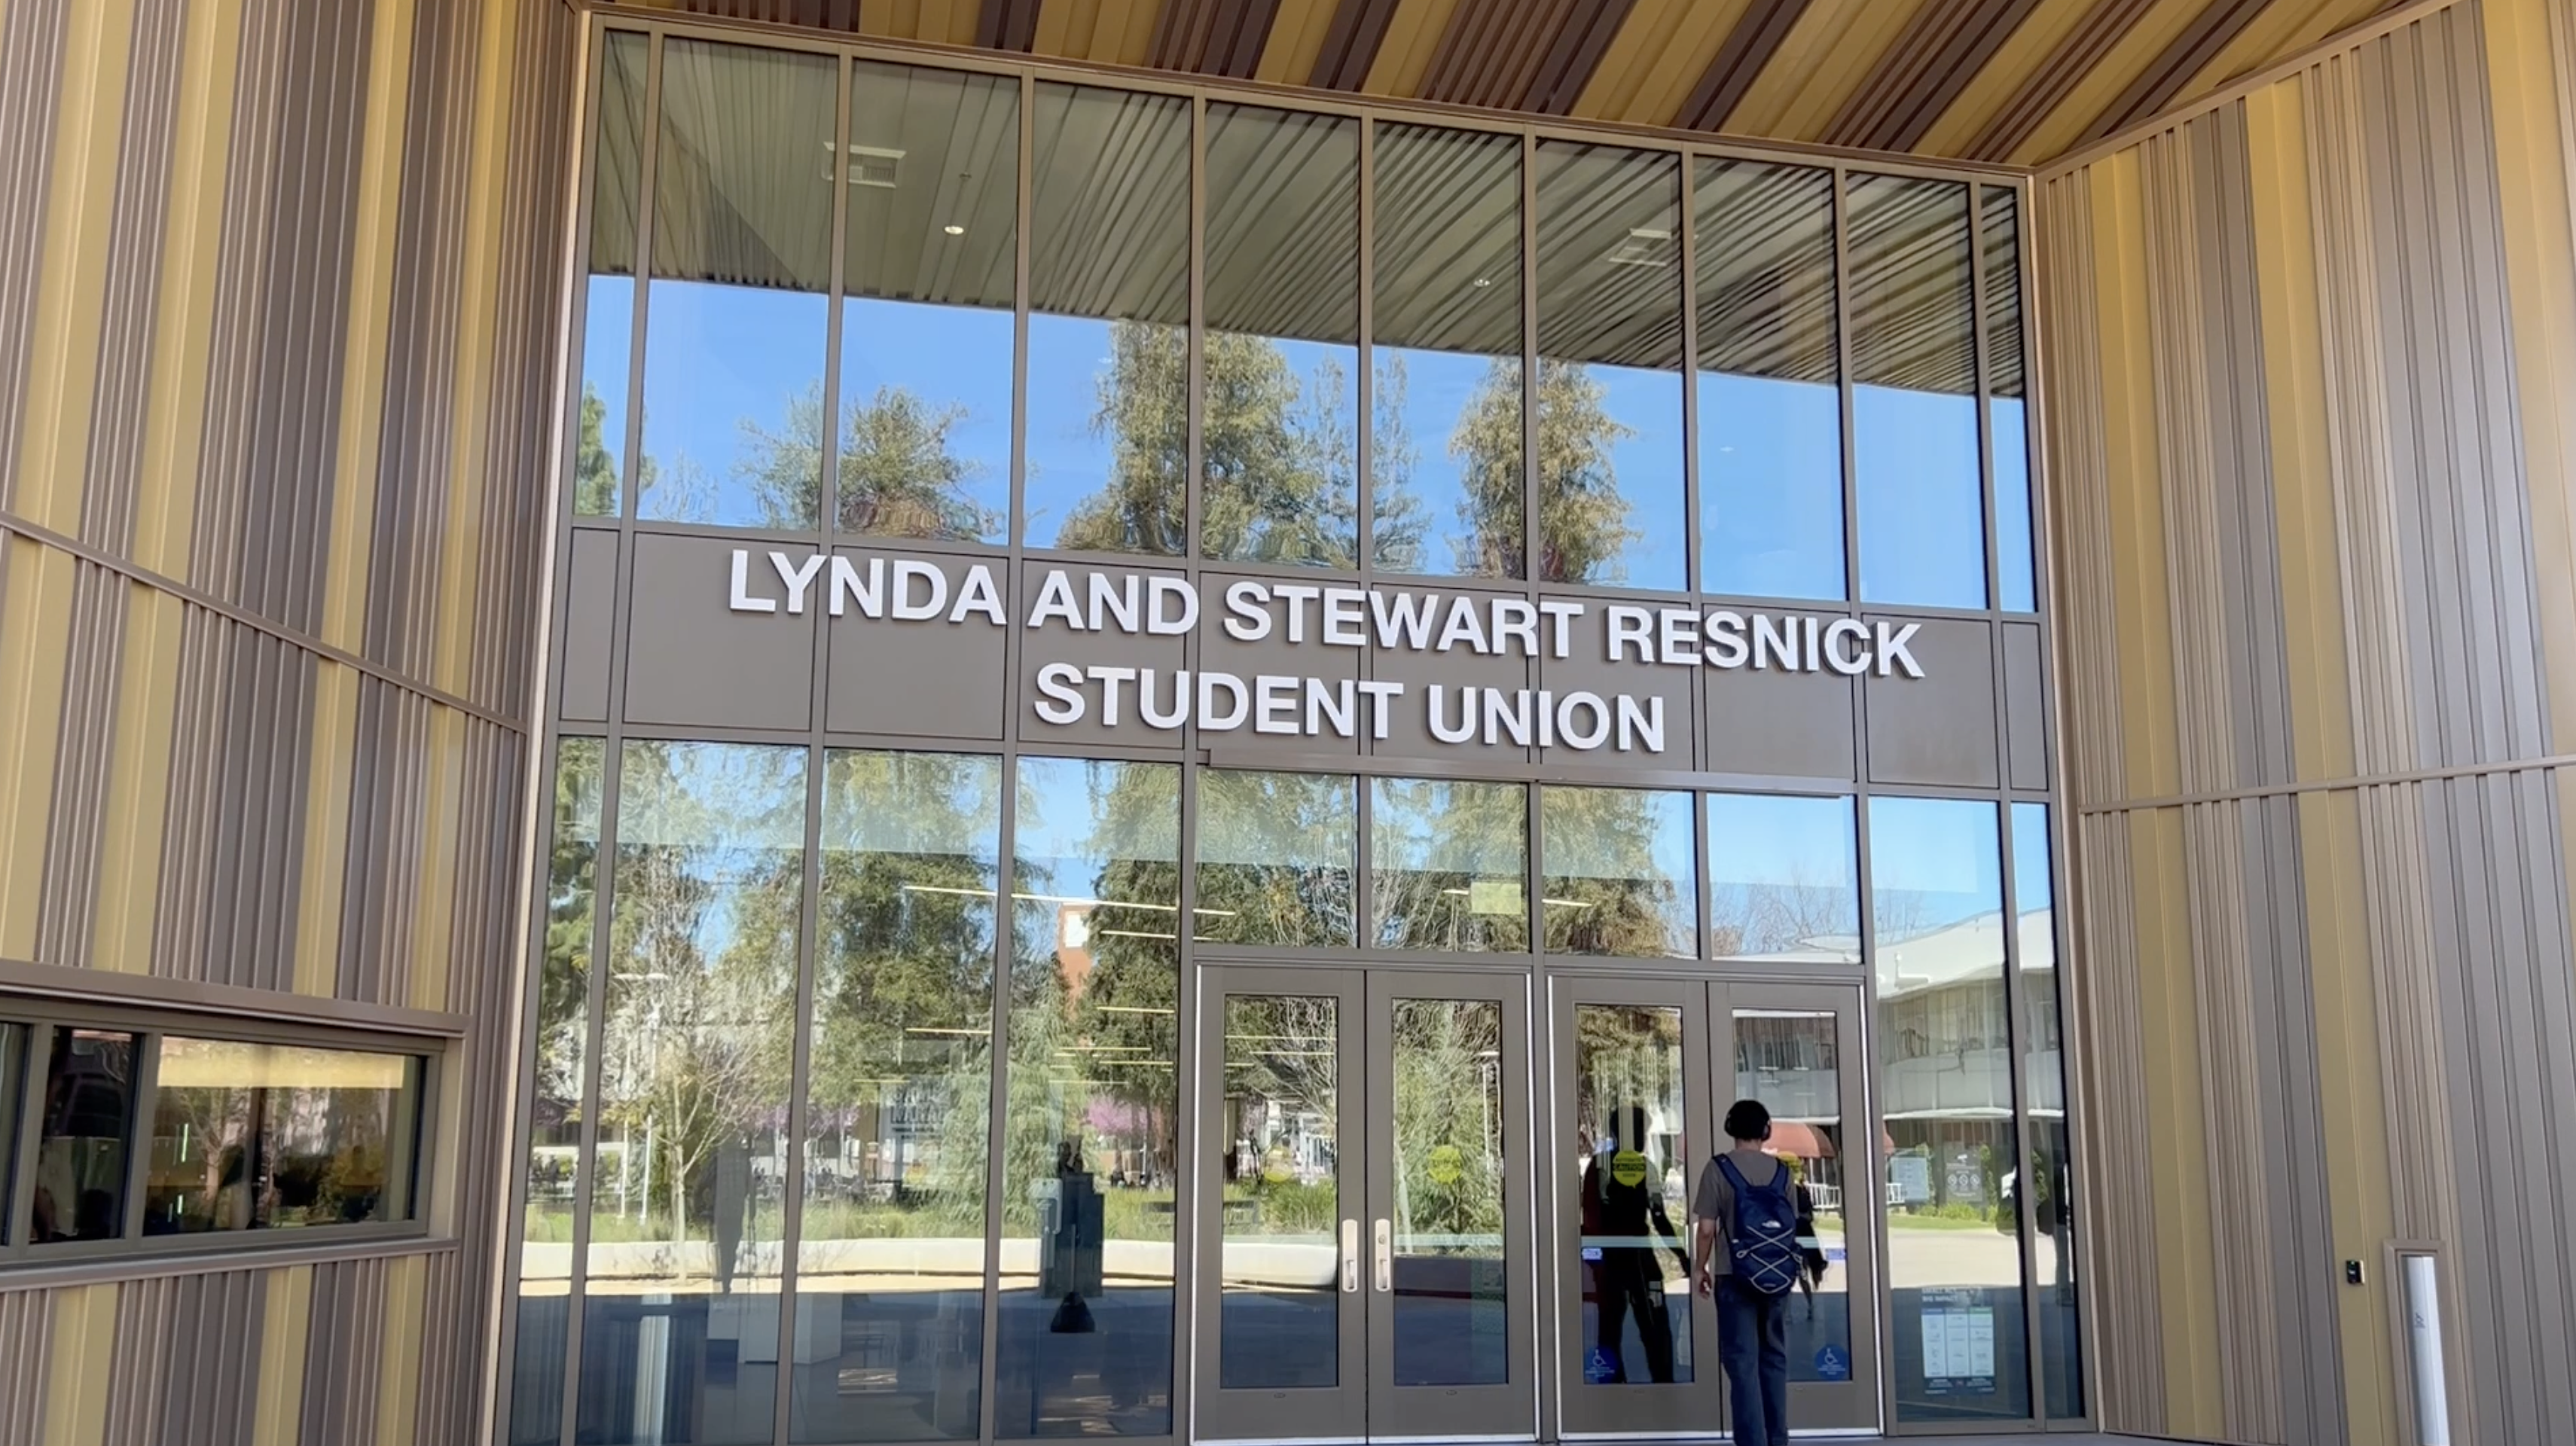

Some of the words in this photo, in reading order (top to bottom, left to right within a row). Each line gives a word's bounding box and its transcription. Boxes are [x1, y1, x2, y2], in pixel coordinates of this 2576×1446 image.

[728, 549, 1008, 625] LYNDA
[1027, 569, 1200, 635] AND
[1223, 581, 1586, 658] STEWART
[1607, 605, 1927, 678] RESNICK
[1033, 663, 1405, 740] STUDENT
[1428, 684, 1665, 753] UNION
